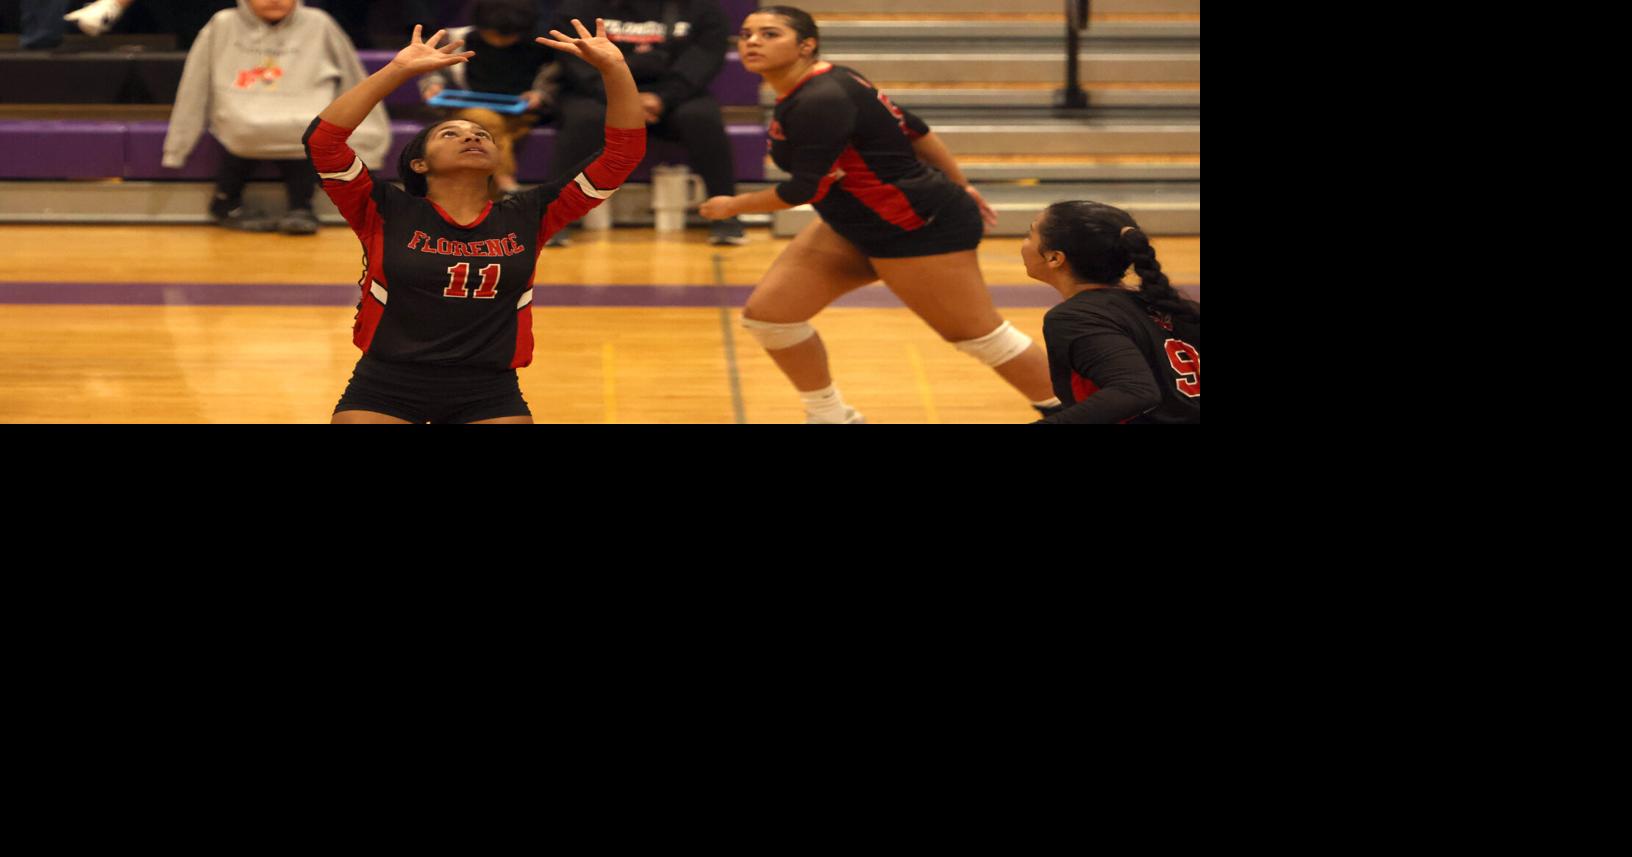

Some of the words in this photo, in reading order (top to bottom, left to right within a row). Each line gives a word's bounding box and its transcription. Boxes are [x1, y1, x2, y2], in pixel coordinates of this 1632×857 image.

[408, 230, 525, 257] FLORENCE
[443, 262, 501, 299] 11
[1164, 338, 1200, 398] 9
